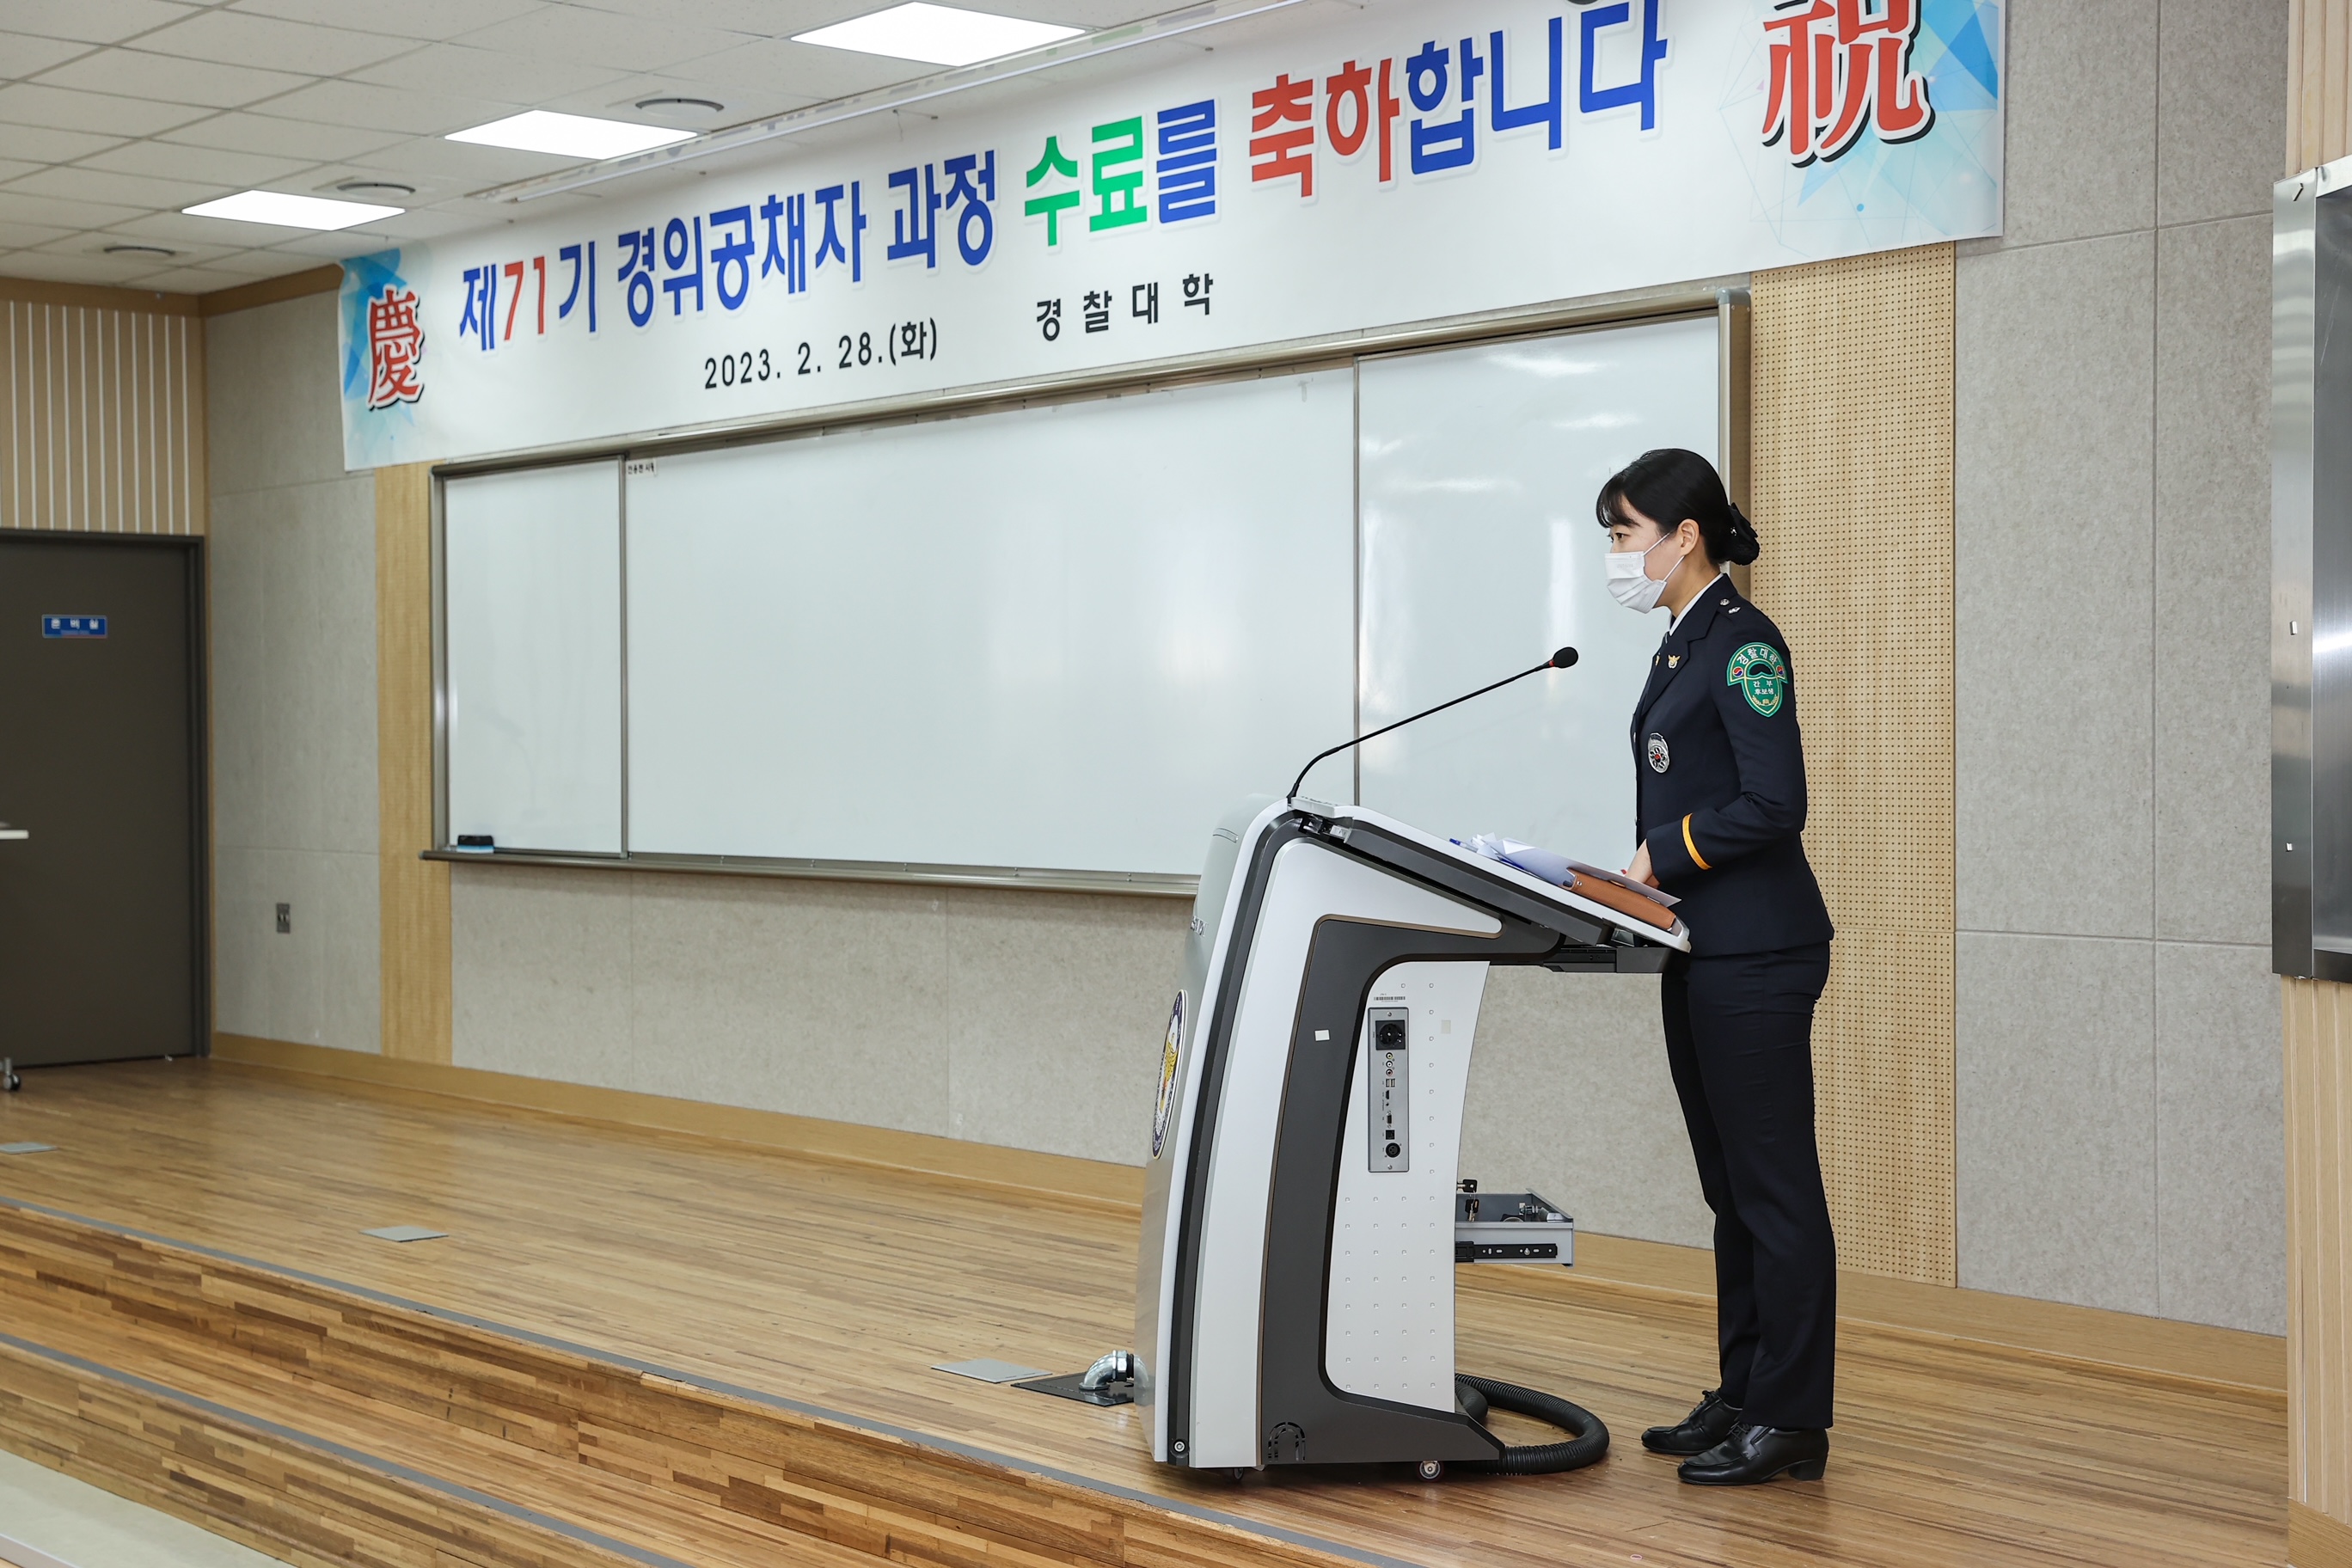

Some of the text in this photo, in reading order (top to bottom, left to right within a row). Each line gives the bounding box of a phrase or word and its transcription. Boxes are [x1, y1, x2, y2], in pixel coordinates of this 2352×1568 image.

[1761, 0, 1926, 156] 祝
[459, 0, 1669, 352] 제71기 경위공채자 과정 수료를 축하합니다
[368, 287, 422, 405] 慶
[705, 317, 938, 389] 2023. 2. 28.(화)
[1736, 647, 1778, 665] 경찰대학
